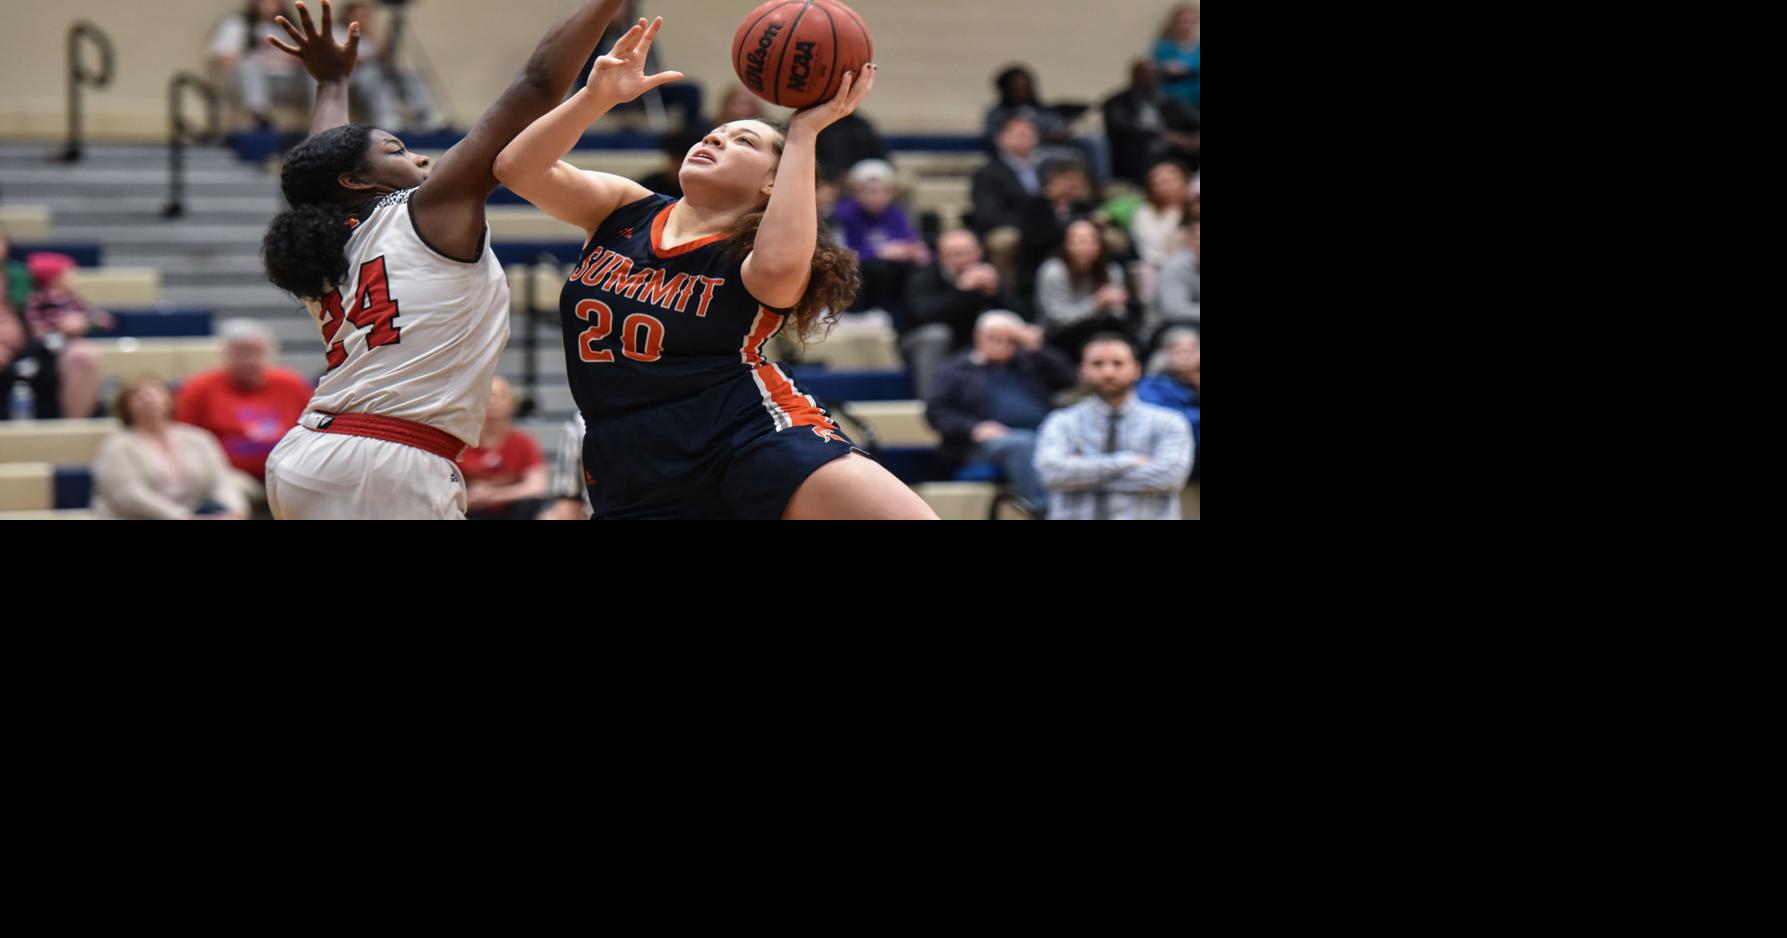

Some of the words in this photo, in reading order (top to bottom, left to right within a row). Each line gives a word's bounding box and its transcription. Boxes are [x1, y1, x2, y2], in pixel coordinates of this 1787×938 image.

[786, 41, 816, 92] NCAA
[320, 255, 400, 371] 24
[569, 246, 725, 317] SUMMIT
[575, 298, 665, 362] 20
